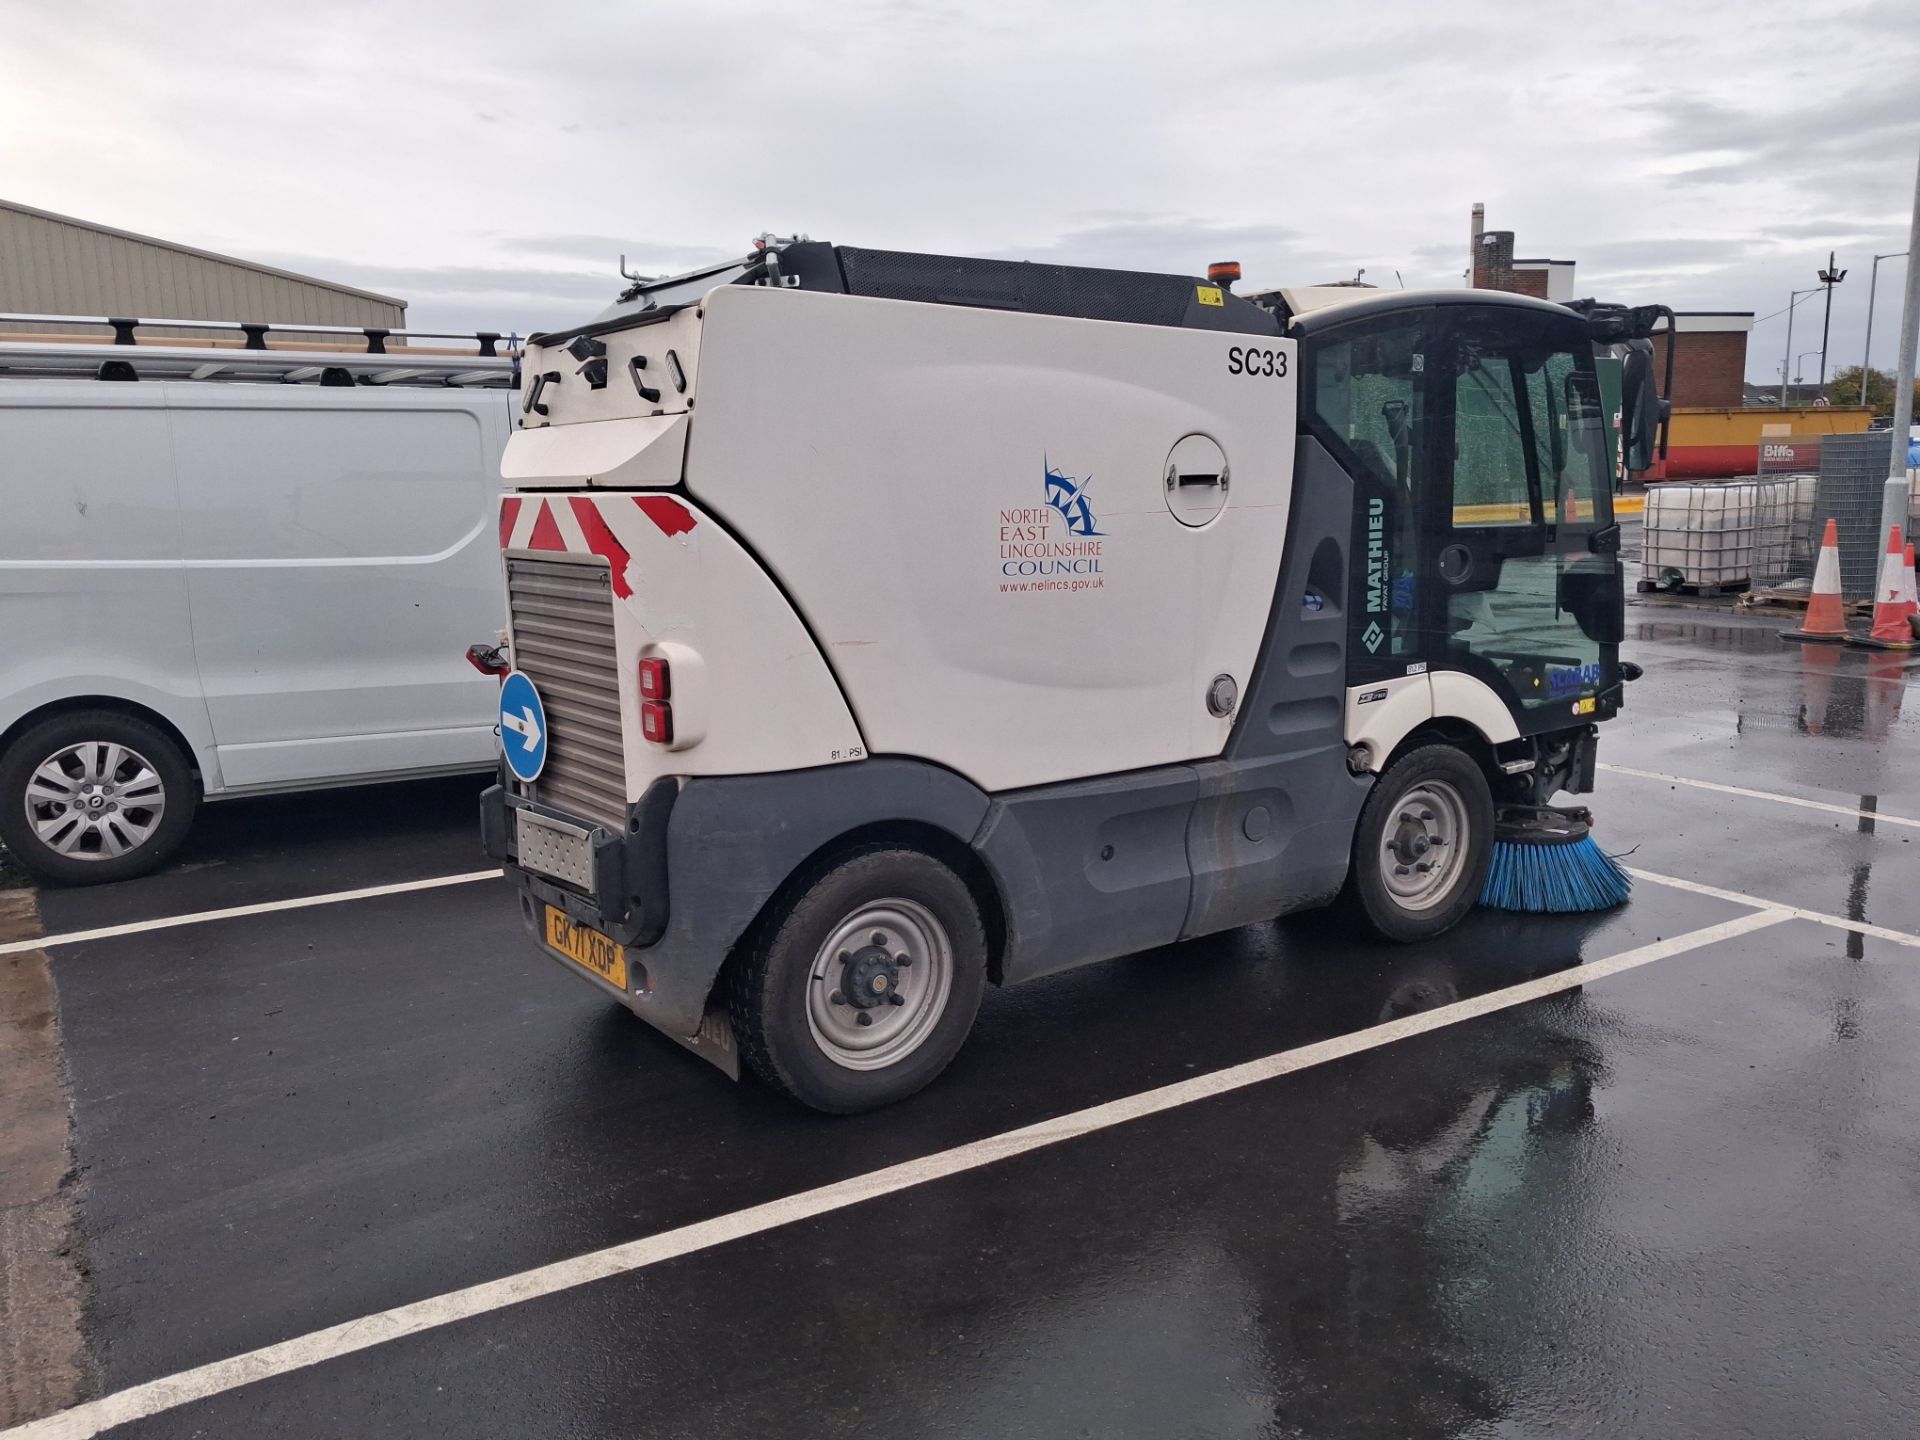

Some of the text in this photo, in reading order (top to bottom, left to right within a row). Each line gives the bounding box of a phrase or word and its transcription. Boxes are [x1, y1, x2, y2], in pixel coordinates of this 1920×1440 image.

[1228, 346, 1288, 378] SC33
[1764, 444, 1794, 457] Biffa
[1000, 508, 1049, 524] NORTH
[1000, 526, 1050, 542] EAST
[1000, 541, 1102, 559] LINCOLNSHIRE
[1367, 498, 1384, 613] MATHIEU
[1002, 558, 1104, 577] COUNCIL
[999, 577, 1104, 593] www.nelincs.gov.uk
[1381, 584, 1390, 611] FAYAT
[849, 747, 862, 757] PSI
